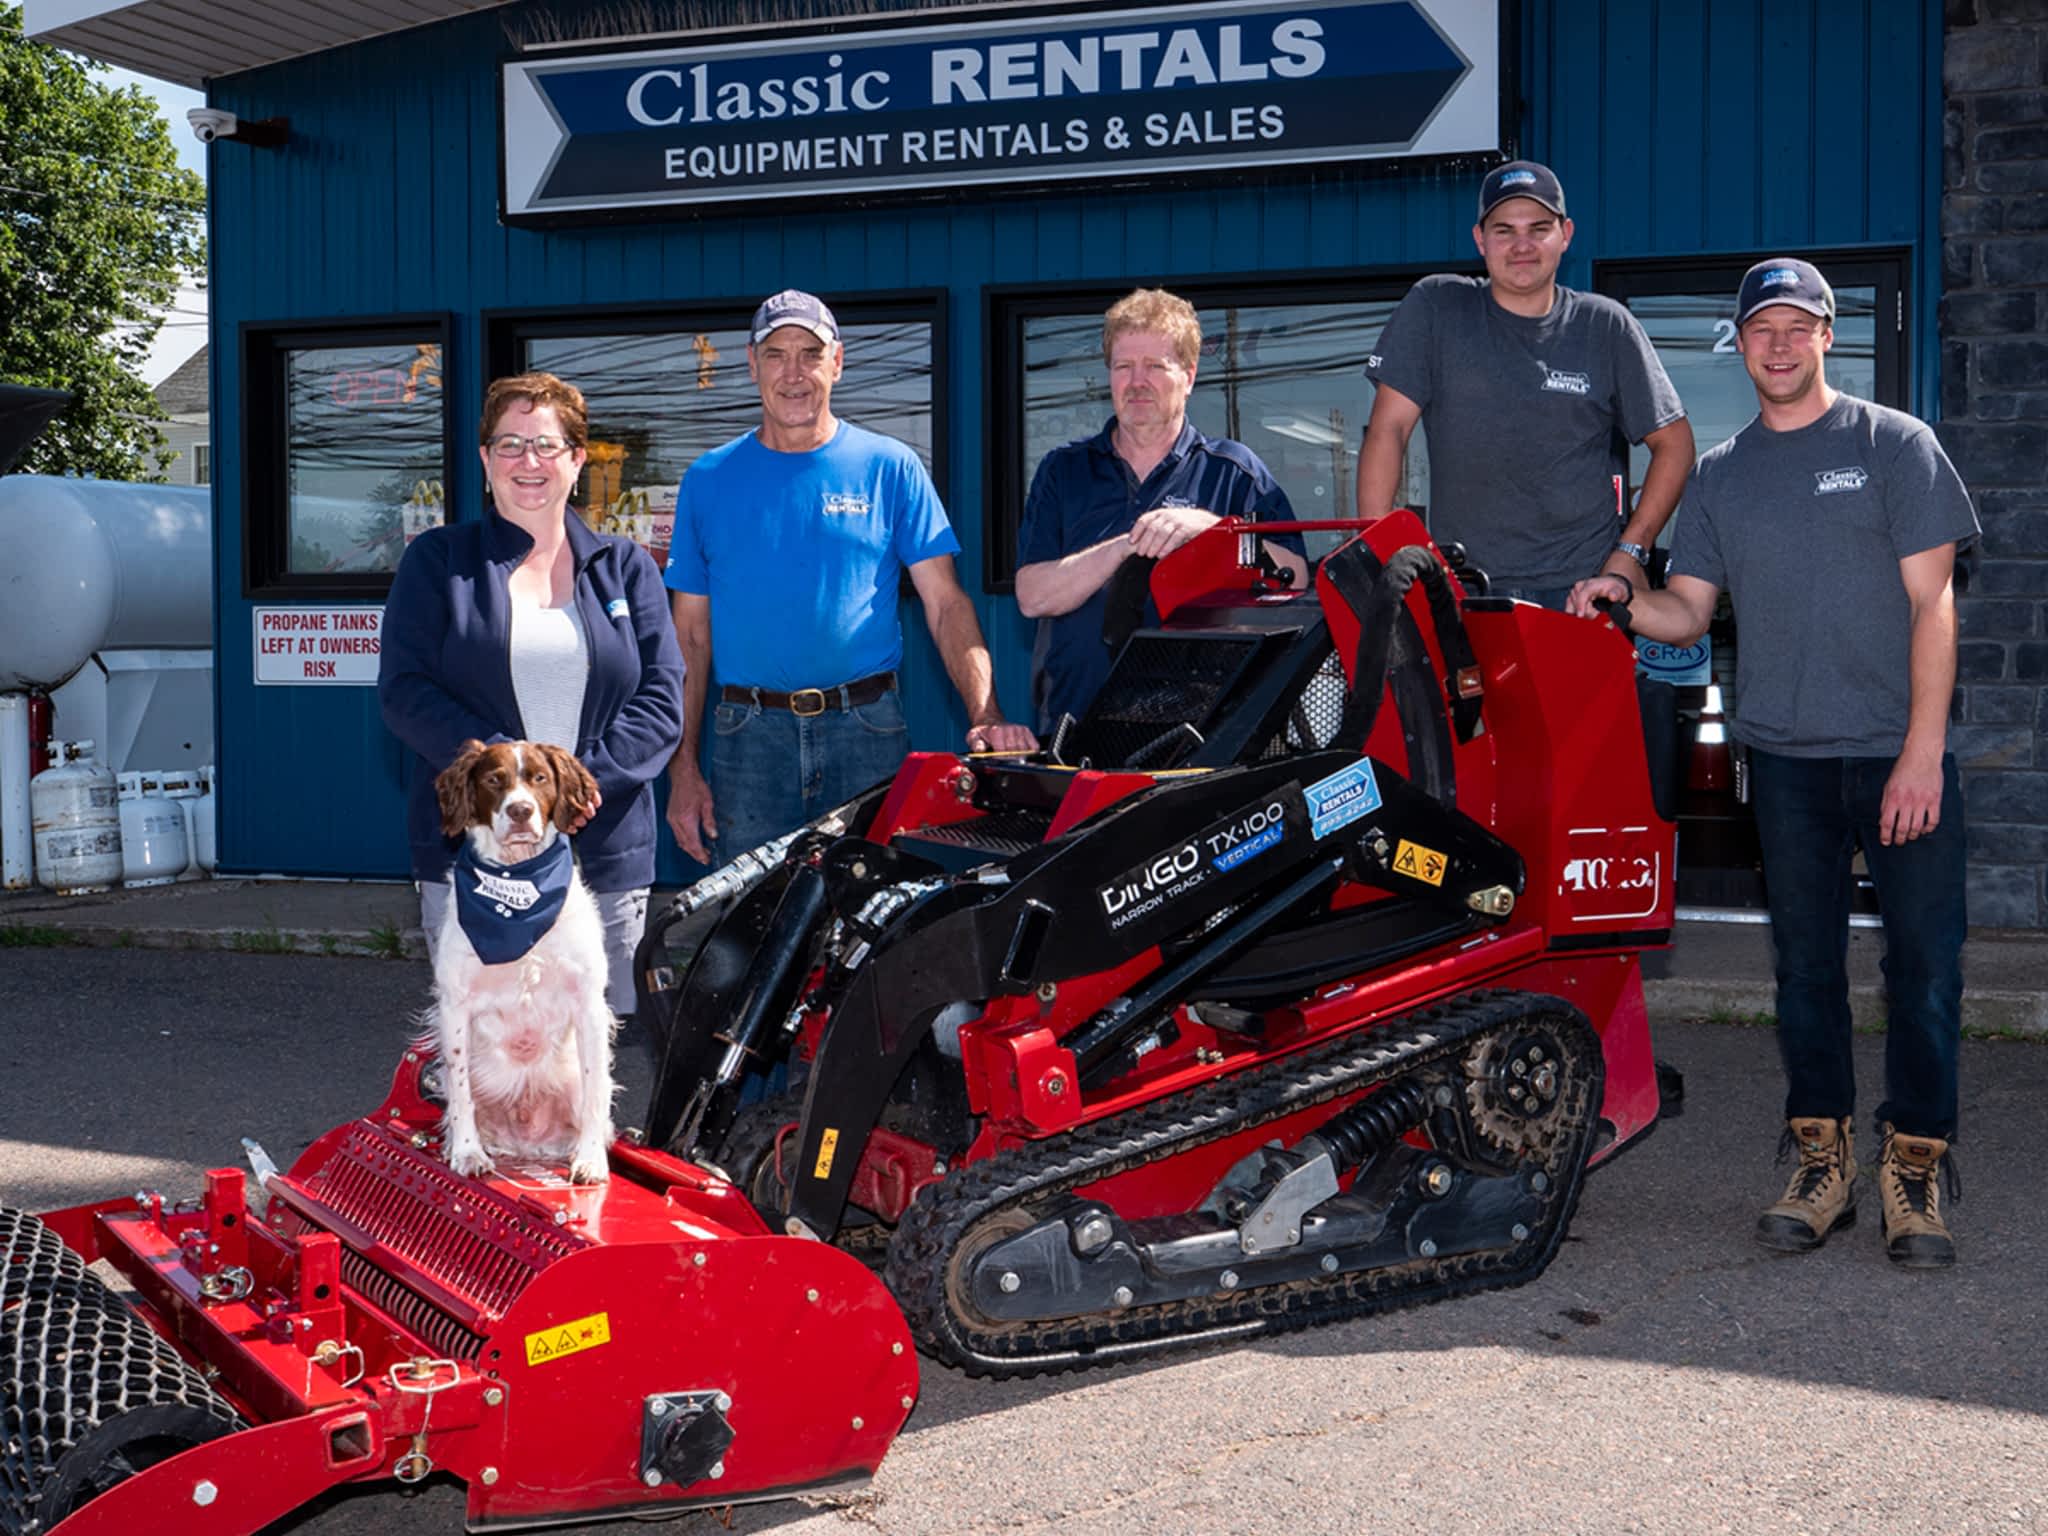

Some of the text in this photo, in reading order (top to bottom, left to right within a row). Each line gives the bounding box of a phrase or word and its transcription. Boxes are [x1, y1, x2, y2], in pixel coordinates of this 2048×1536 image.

[625, 18, 1327, 126] Classic RENTALS
[665, 105, 1285, 180] EQUIPMENT RENTALS & SALES
[332, 368, 417, 405] OPEN
[1819, 478, 1863, 490] RENTALS
[262, 613, 379, 631] PROPANE TANKS
[260, 636, 381, 655] LEFT AT OWNERS
[303, 660, 337, 678] RISK
[1320, 784, 1363, 813] RENTALS
[1111, 830, 1280, 930] NARROW TRACK VERTICAL
[482, 883, 531, 907] RENTALS
